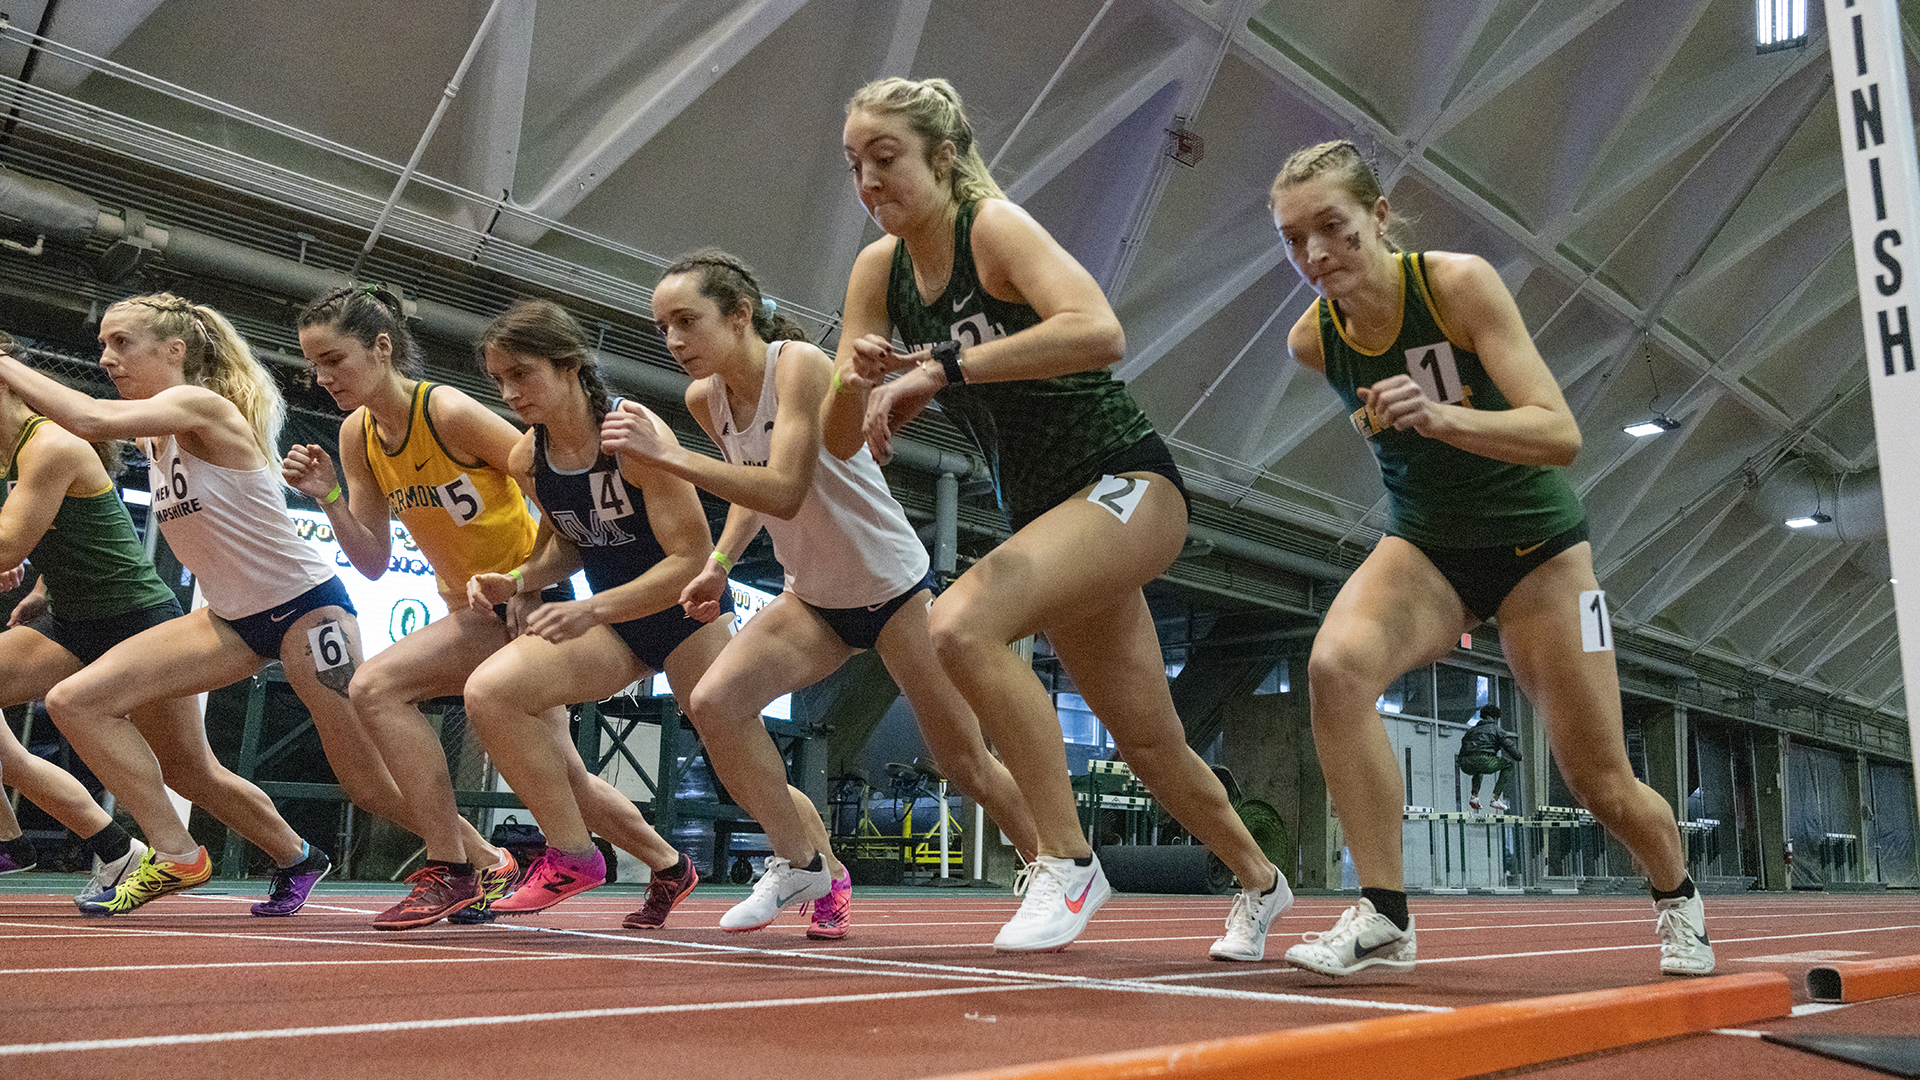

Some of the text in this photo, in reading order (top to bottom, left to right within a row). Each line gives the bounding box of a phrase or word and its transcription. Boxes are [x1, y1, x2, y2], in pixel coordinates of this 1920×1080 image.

[1845, 0, 1916, 377] INISH
[1420, 348, 1449, 402] 1
[172, 457, 188, 500] 6
[387, 484, 445, 515] ERMON
[600, 473, 625, 515] 4
[1098, 476, 1137, 516] 2
[153, 498, 203, 524] MPSHIRE
[444, 479, 478, 521] 5
[1589, 594, 1605, 648] 1
[318, 626, 342, 666] 6
